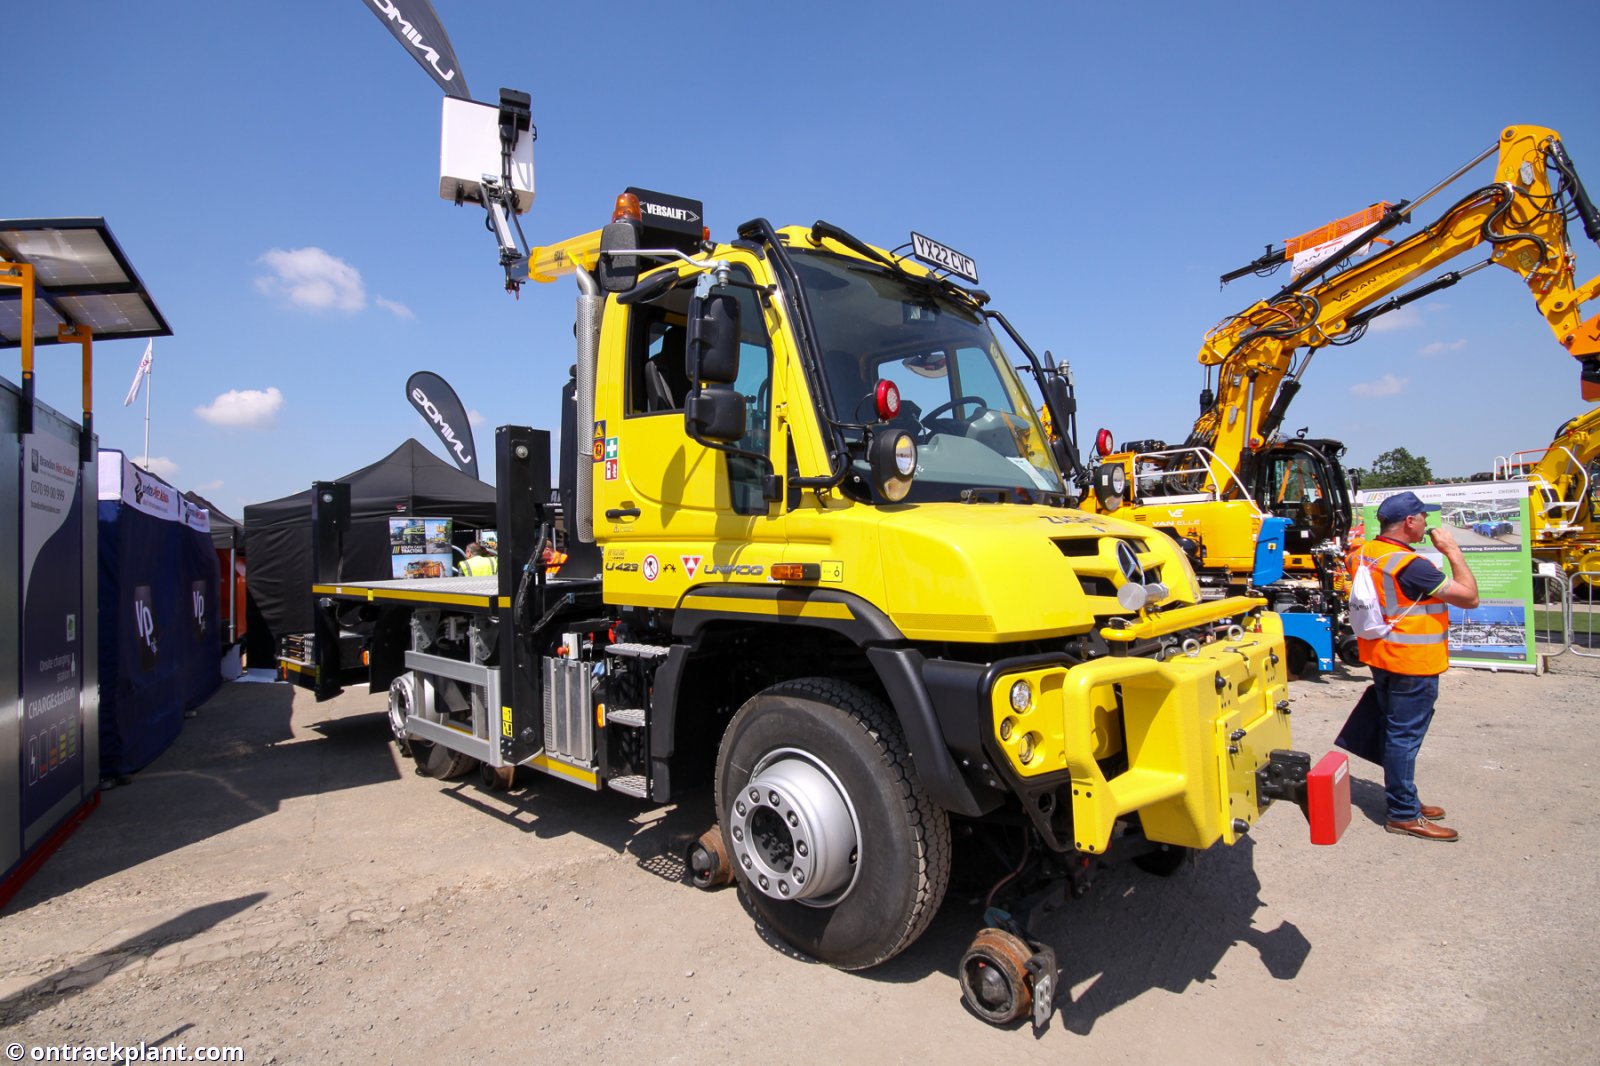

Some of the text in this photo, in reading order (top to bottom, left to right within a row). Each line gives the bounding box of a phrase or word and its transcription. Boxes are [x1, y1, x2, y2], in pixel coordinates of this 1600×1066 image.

[646, 203, 687, 221] VERSALIFT
[917, 236, 972, 275] YX22 CVC
[40, 455, 55, 470] Brandon
[31, 480, 43, 495] 0370
[44, 484, 50, 497] 99
[605, 563, 639, 572] U 423
[704, 564, 765, 576] UNIMOG
[135, 600, 154, 646] Vp
[28, 686, 76, 719] CHARGEstation
